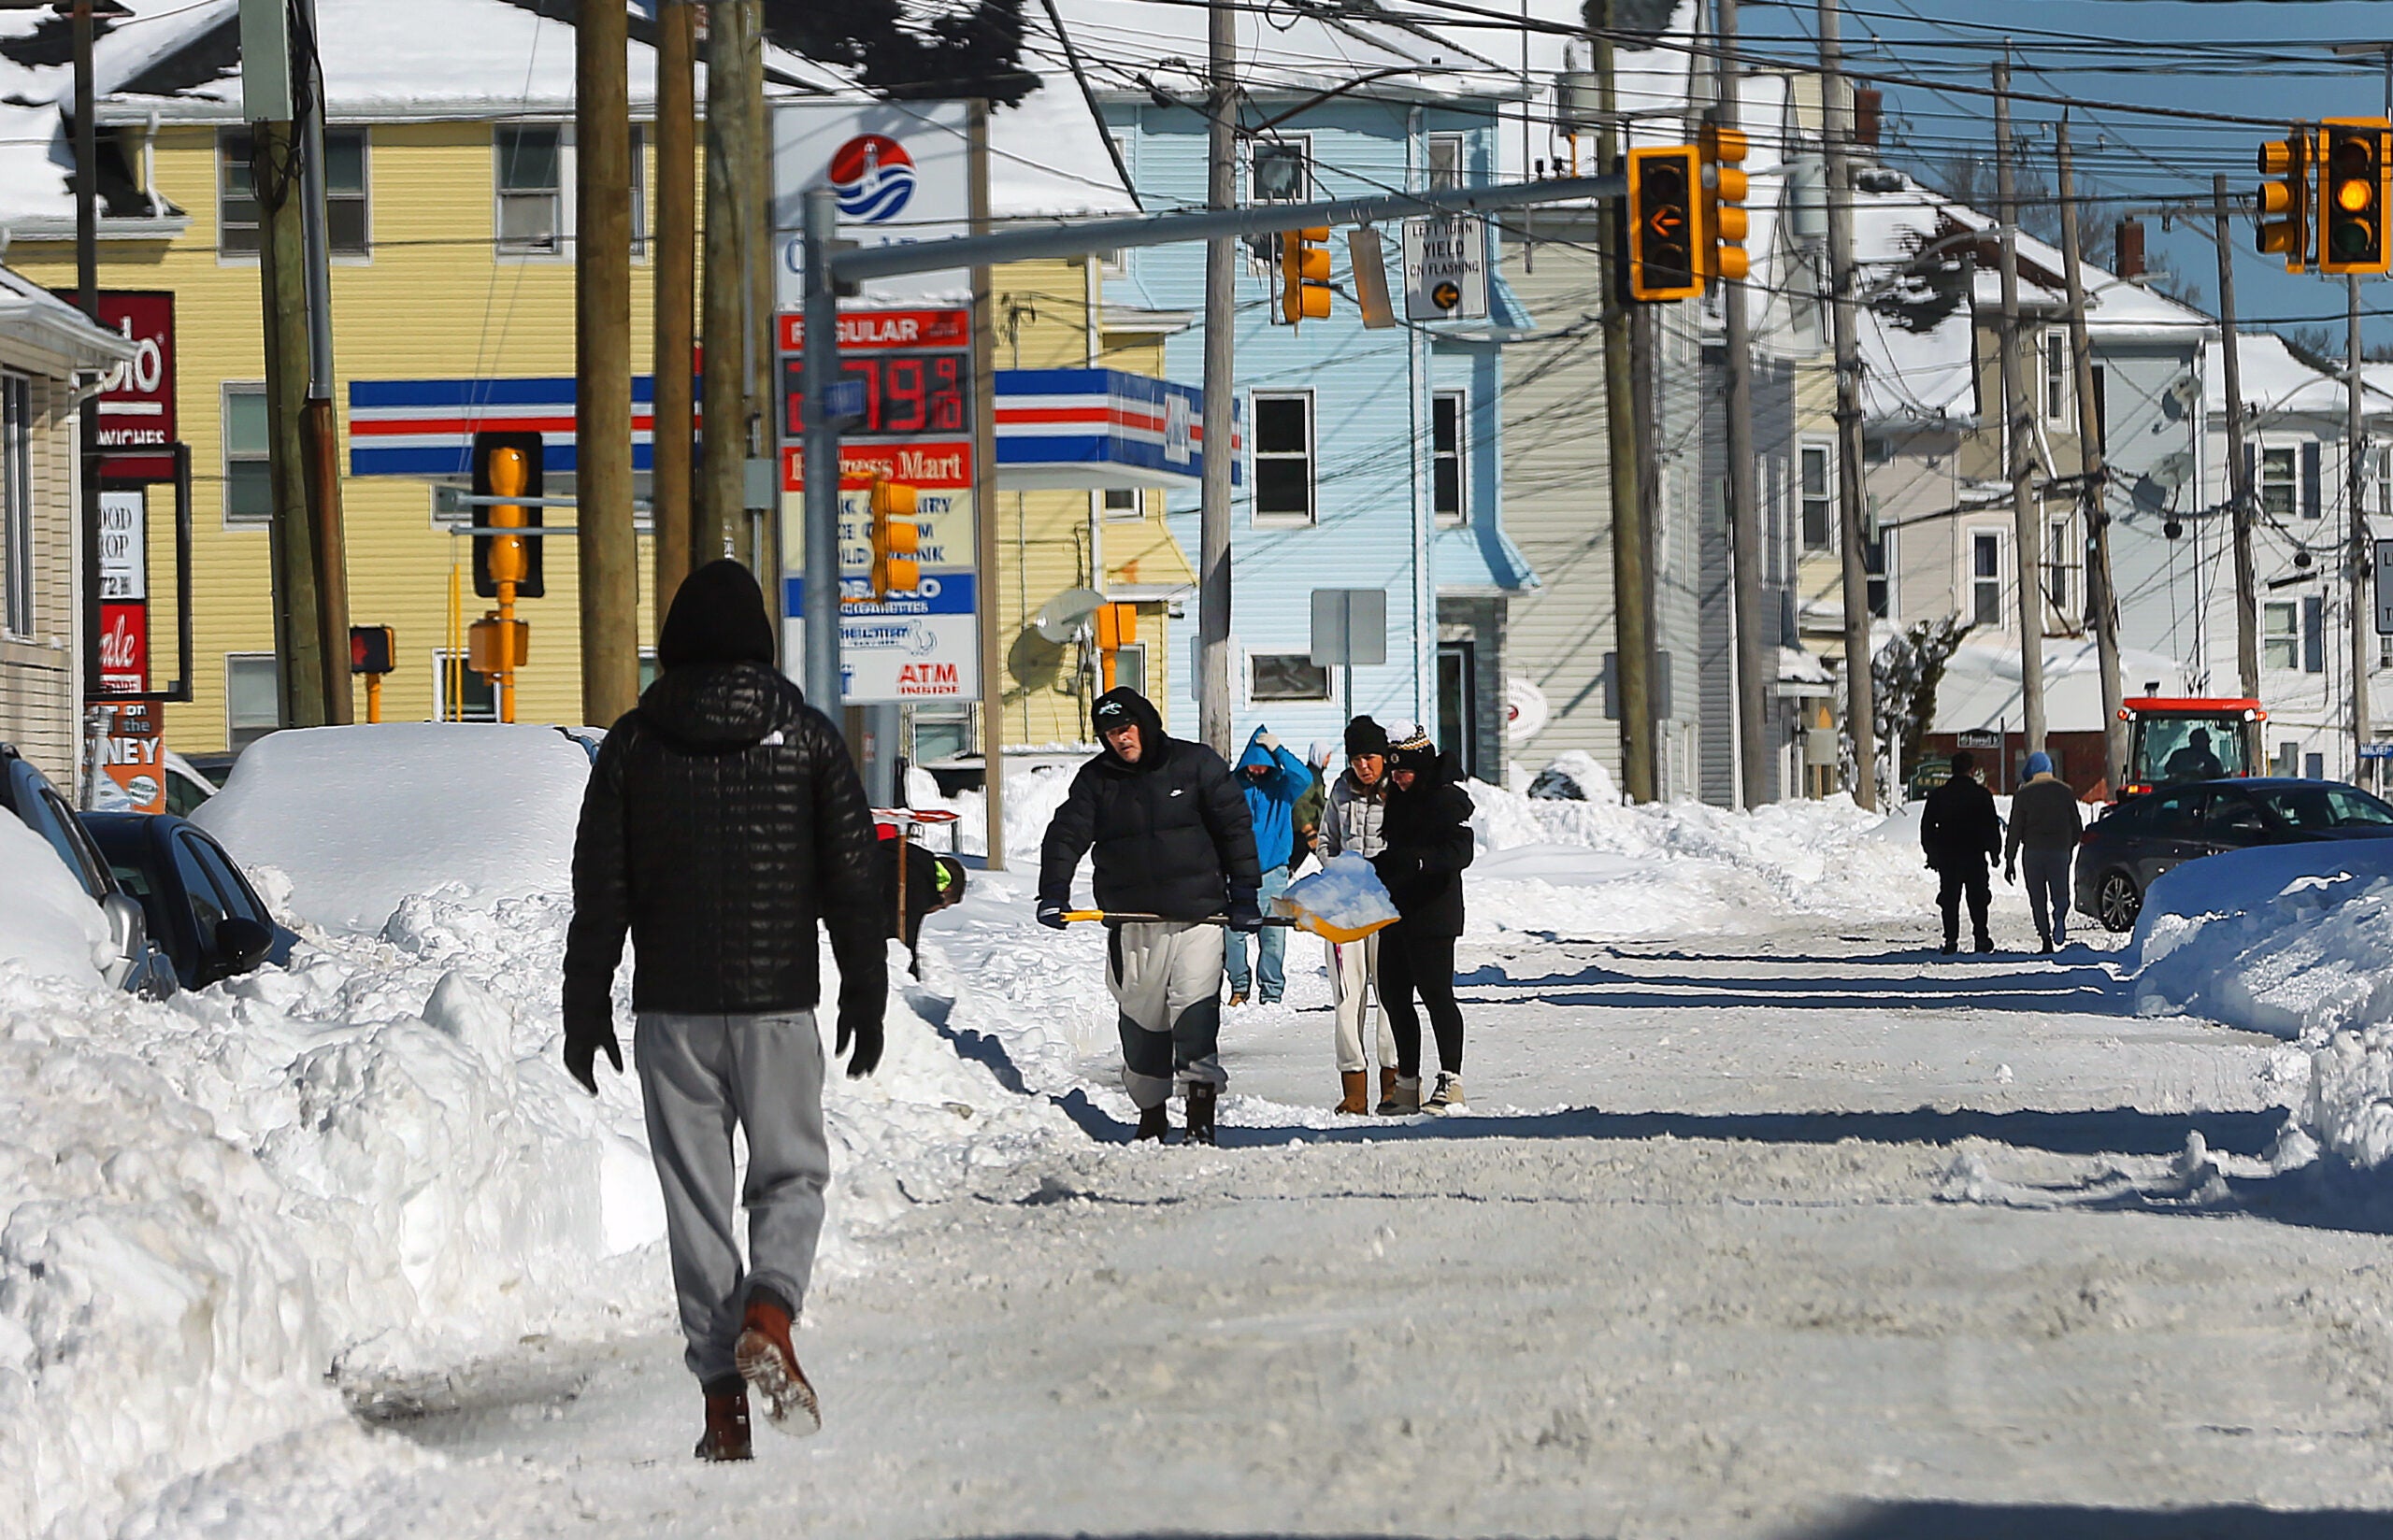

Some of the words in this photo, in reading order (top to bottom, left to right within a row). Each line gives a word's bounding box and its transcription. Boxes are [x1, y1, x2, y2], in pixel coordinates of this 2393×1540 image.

[1411, 224, 1439, 237] LEFT
[1444, 222, 1472, 235] TURN
[1422, 240, 1465, 258] YIELD
[1410, 263, 1424, 278] ON
[1428, 261, 1479, 277] FLASHING
[897, 450, 962, 481] Mart
[898, 663, 959, 684] ATM
[899, 686, 960, 695] INSIDE
[123, 705, 147, 717] on
[122, 718, 150, 732] the
[100, 736, 160, 765] NEY
